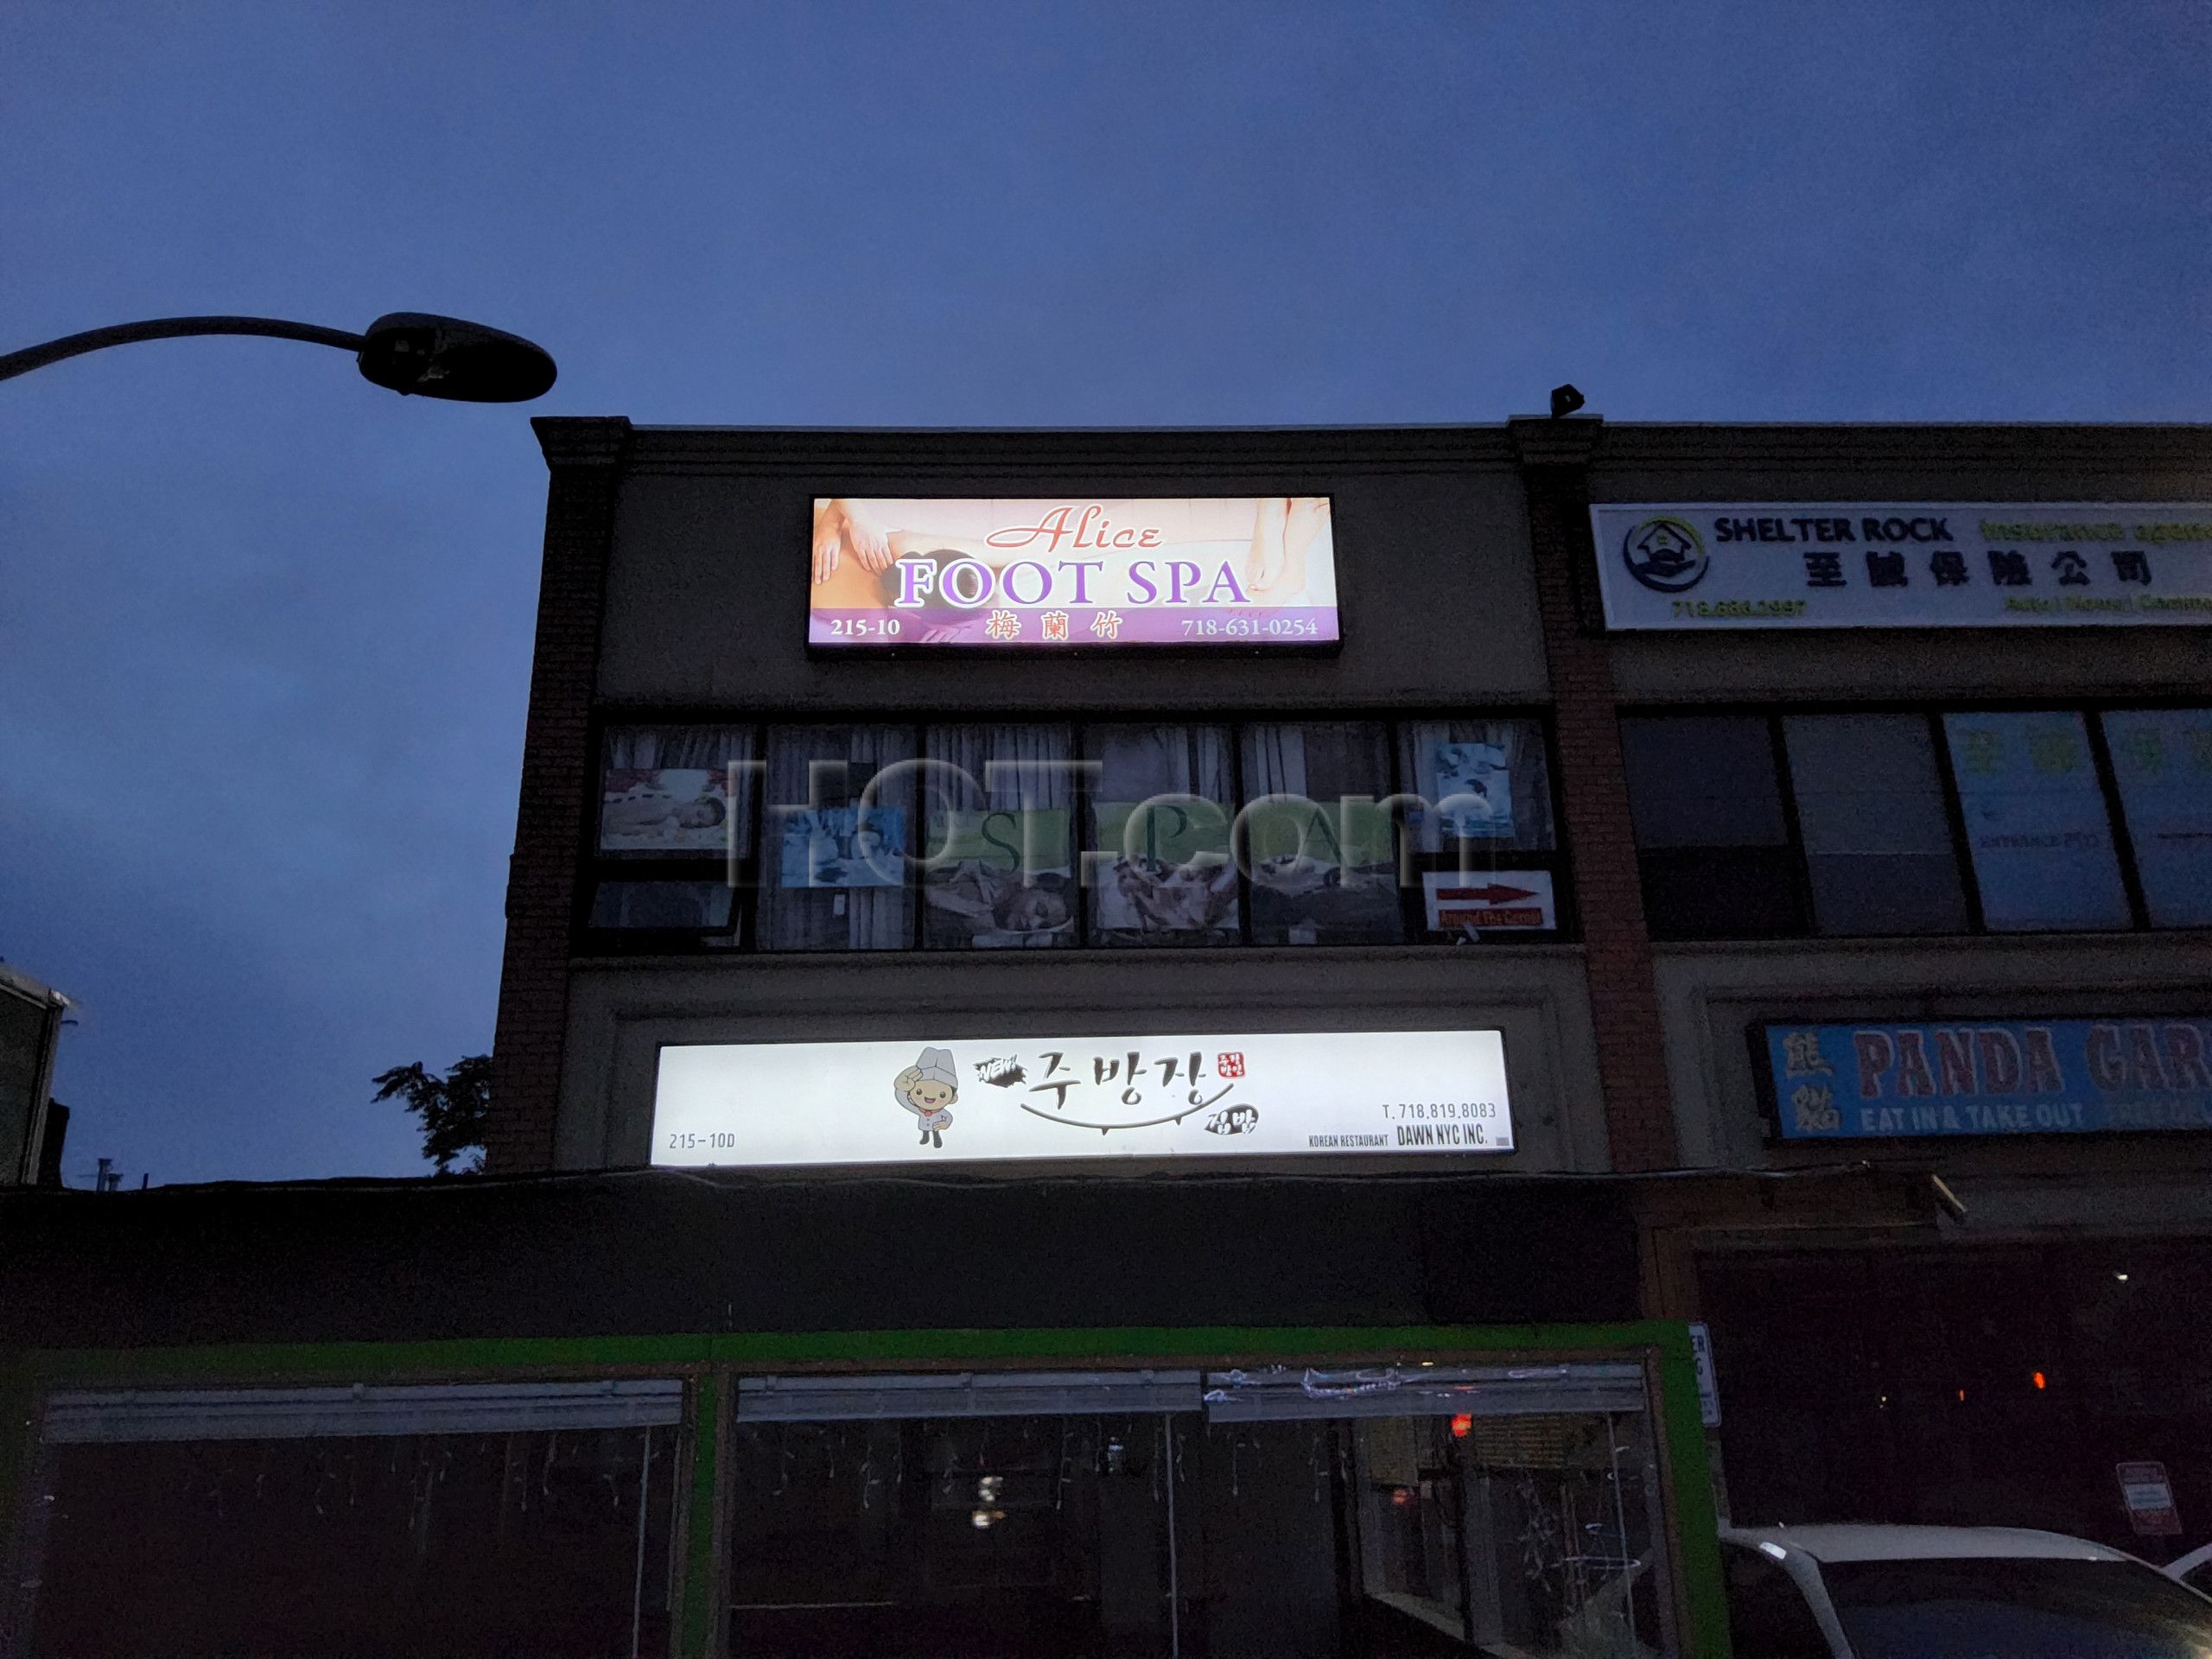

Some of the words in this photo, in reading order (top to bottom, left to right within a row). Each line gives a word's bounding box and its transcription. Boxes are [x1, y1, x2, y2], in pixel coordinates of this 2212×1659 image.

[986, 506, 1163, 553] Alice
[1715, 518, 1854, 542] SHELTER
[1863, 518, 1953, 542] ROCK
[895, 560, 1104, 606] FOOT
[1127, 561, 1251, 605] SPA
[830, 618, 901, 636] 215-10
[987, 612, 1122, 639] 梅蘭竹
[1180, 618, 1319, 636] 718-631-0254
[1852, 1026, 2066, 1099] PANDA
[1860, 1108, 1906, 1132] EAT
[1965, 1104, 2033, 1129] TAKE
[2036, 1103, 2083, 1128] OUT
[1308, 1134, 1338, 1147] KOREAN
[1340, 1133, 1389, 1147] RESTAURANT
[1396, 1125, 1434, 1147] DAWN
[1436, 1124, 1461, 1145] NYC
[1463, 1123, 1489, 1145] INC.
